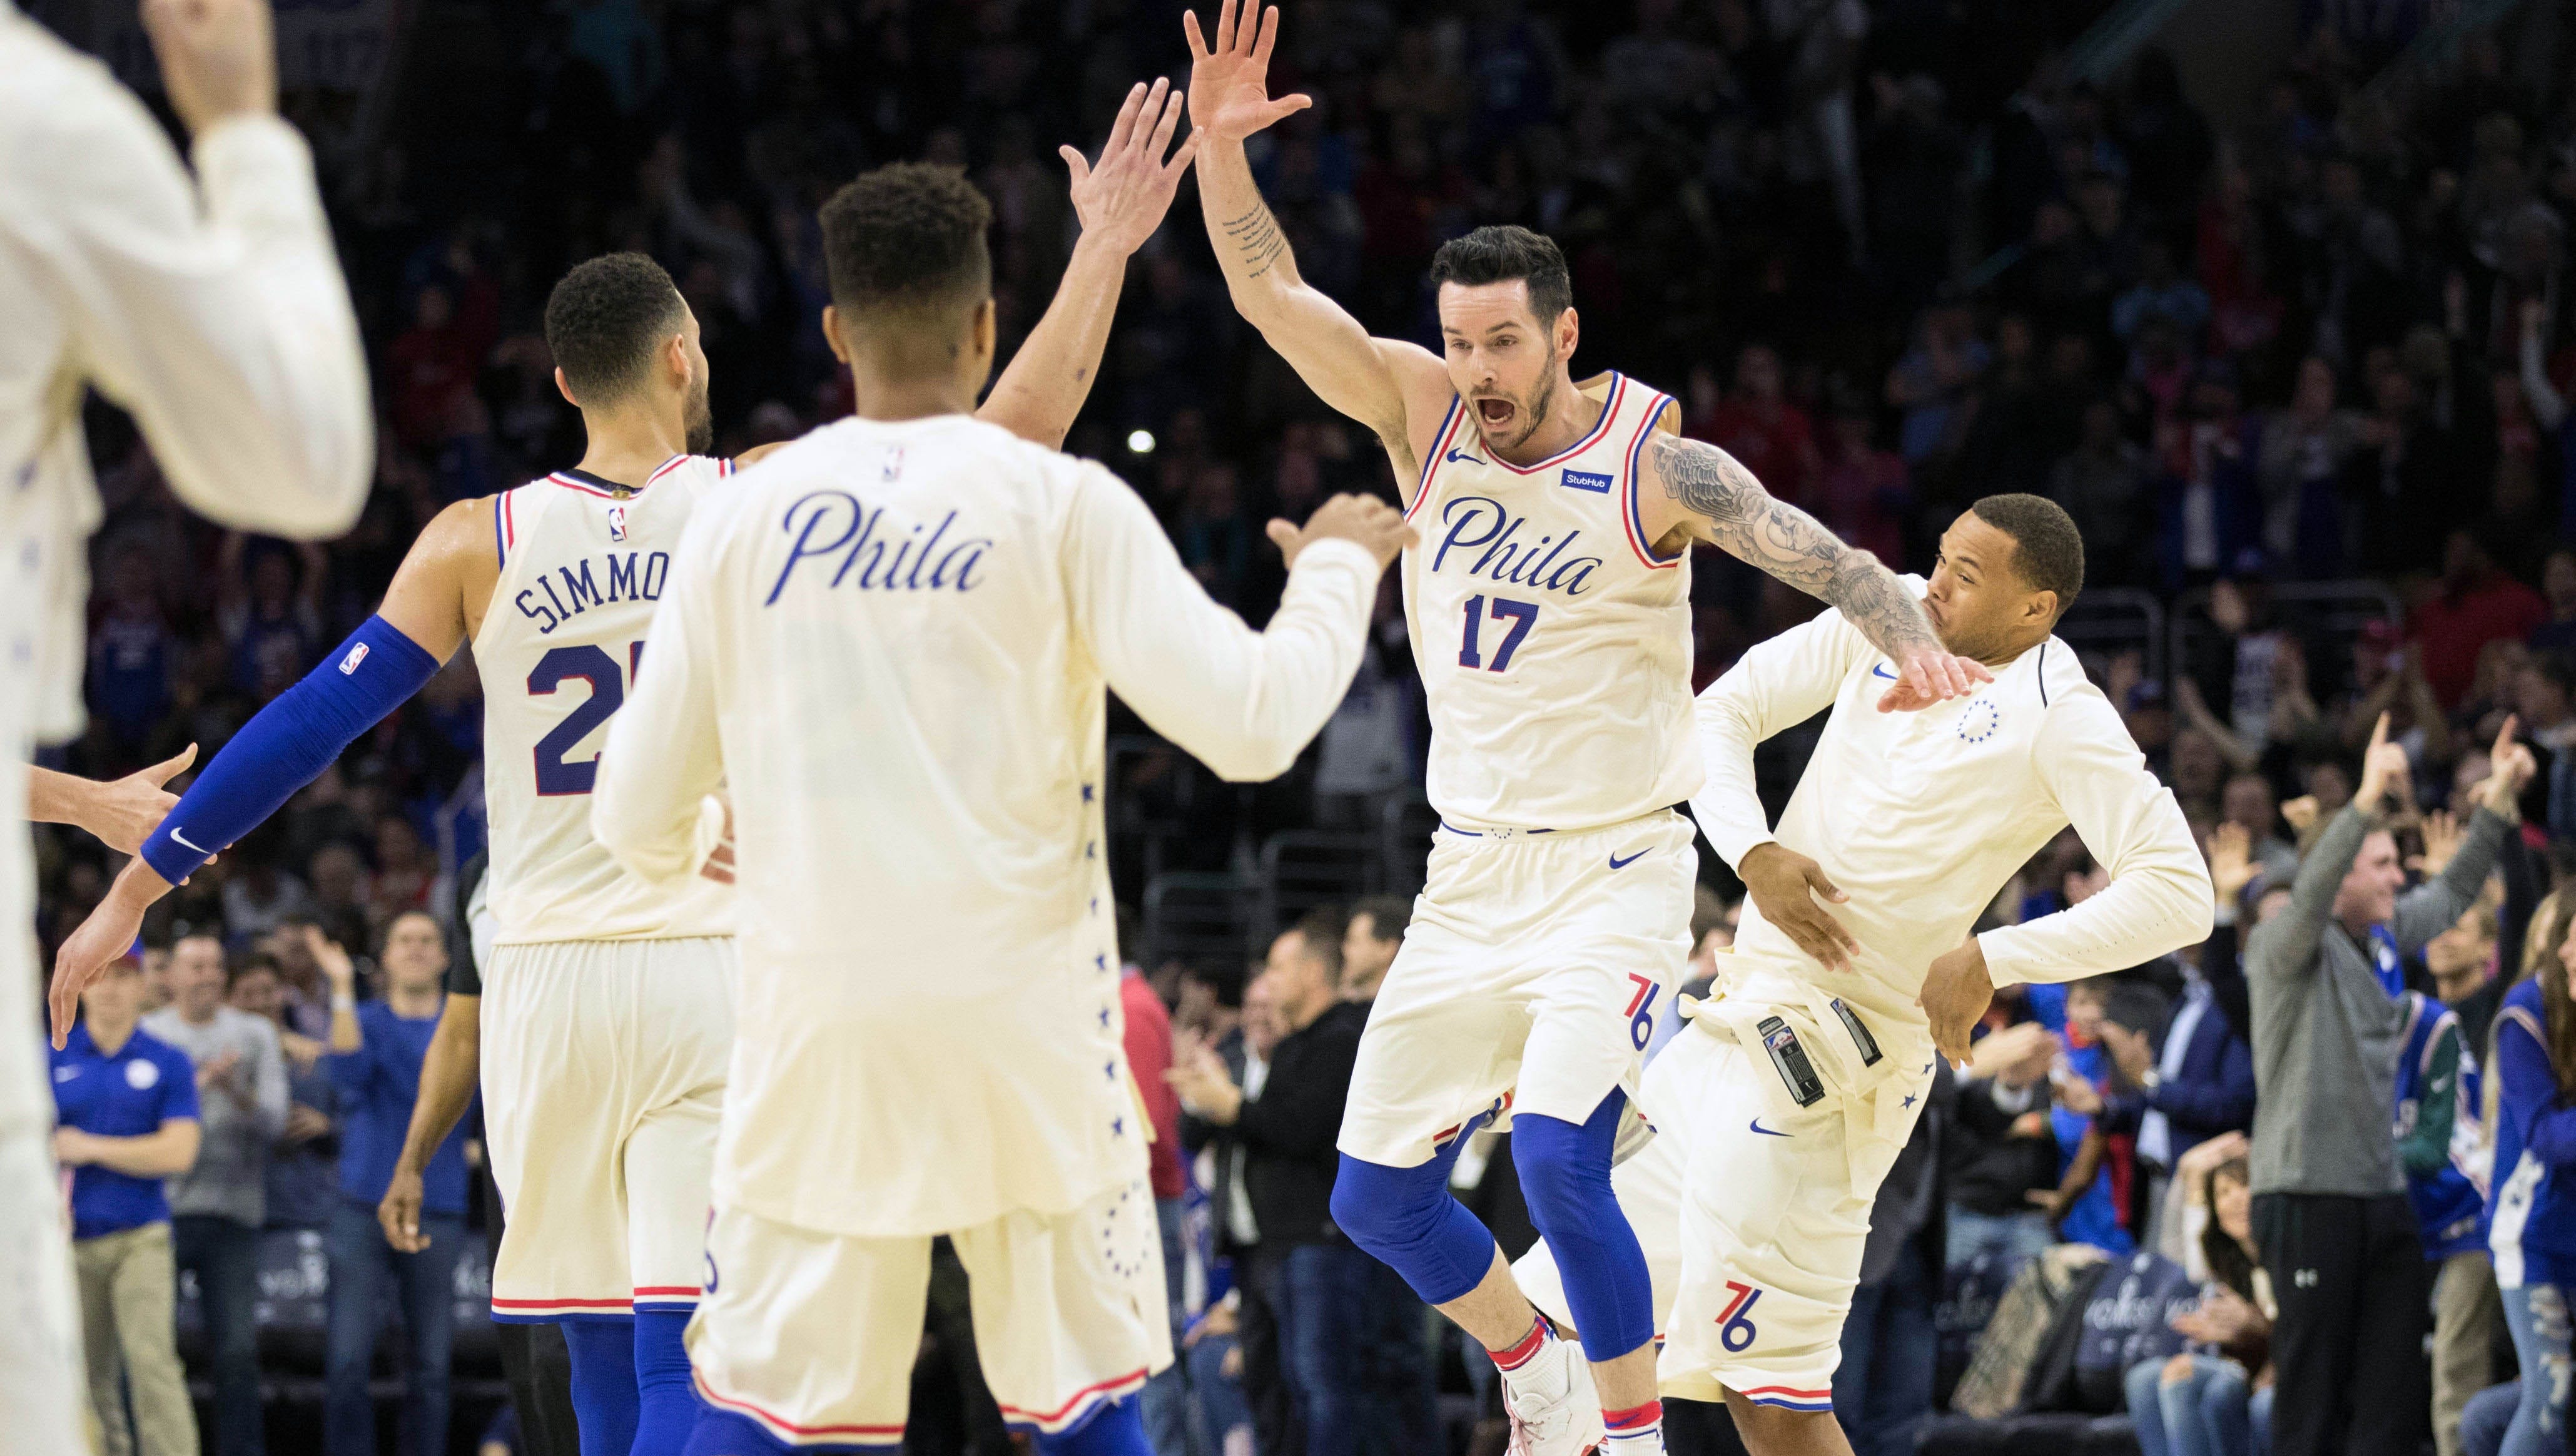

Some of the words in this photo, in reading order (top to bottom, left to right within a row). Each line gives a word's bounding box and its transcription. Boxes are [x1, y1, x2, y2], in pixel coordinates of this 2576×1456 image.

[1566, 474, 1605, 487] StubHub
[764, 491, 993, 607] Phila
[1433, 496, 1603, 596] Phila
[1458, 594, 1539, 673] 17
[527, 640, 646, 797] 2
[1624, 972, 1660, 1051] 76
[1715, 1280, 1762, 1352] 76
